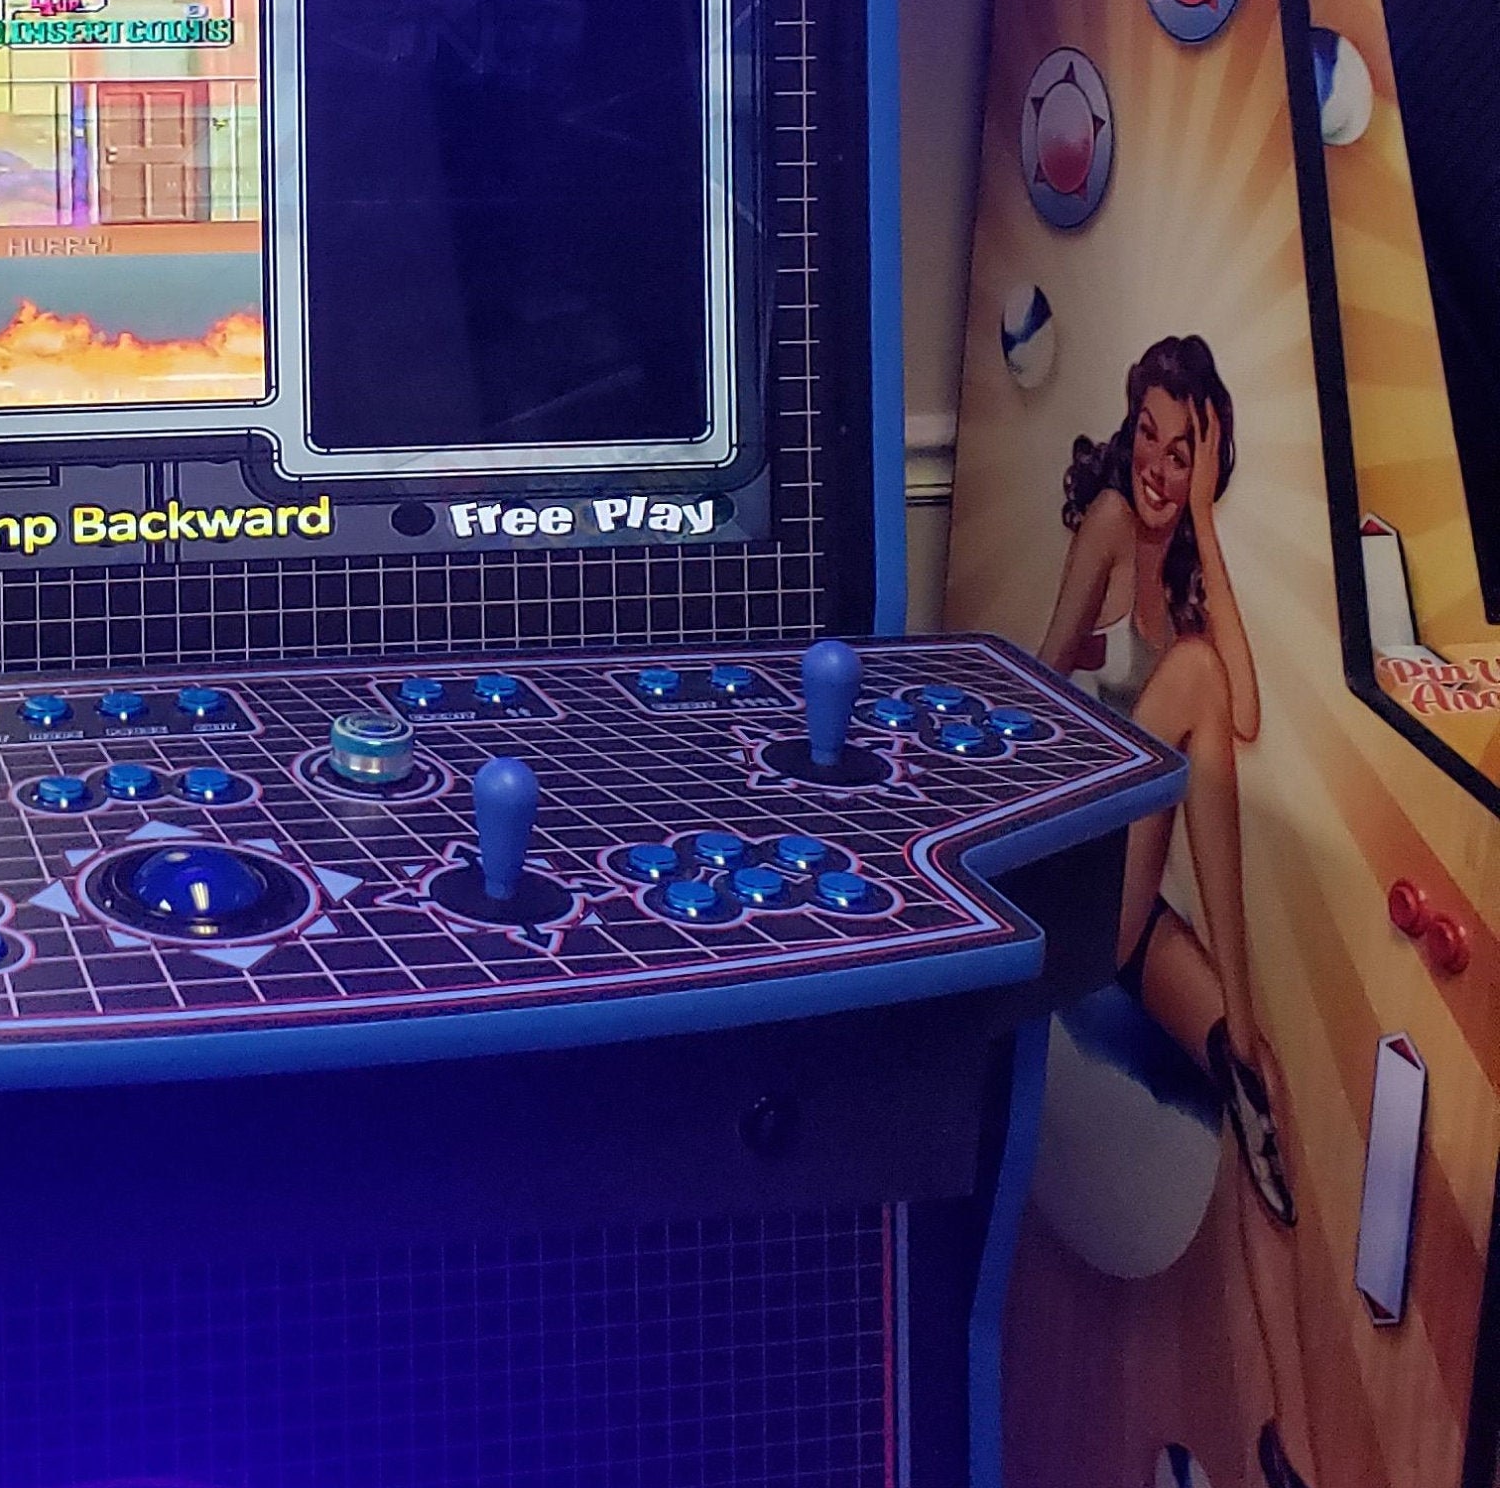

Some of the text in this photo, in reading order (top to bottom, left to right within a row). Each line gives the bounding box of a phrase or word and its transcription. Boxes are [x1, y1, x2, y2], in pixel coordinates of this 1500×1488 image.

[71, 497, 331, 545] Backward
[449, 496, 717, 538] Free Play
[1379, 656, 1476, 684] Pin
